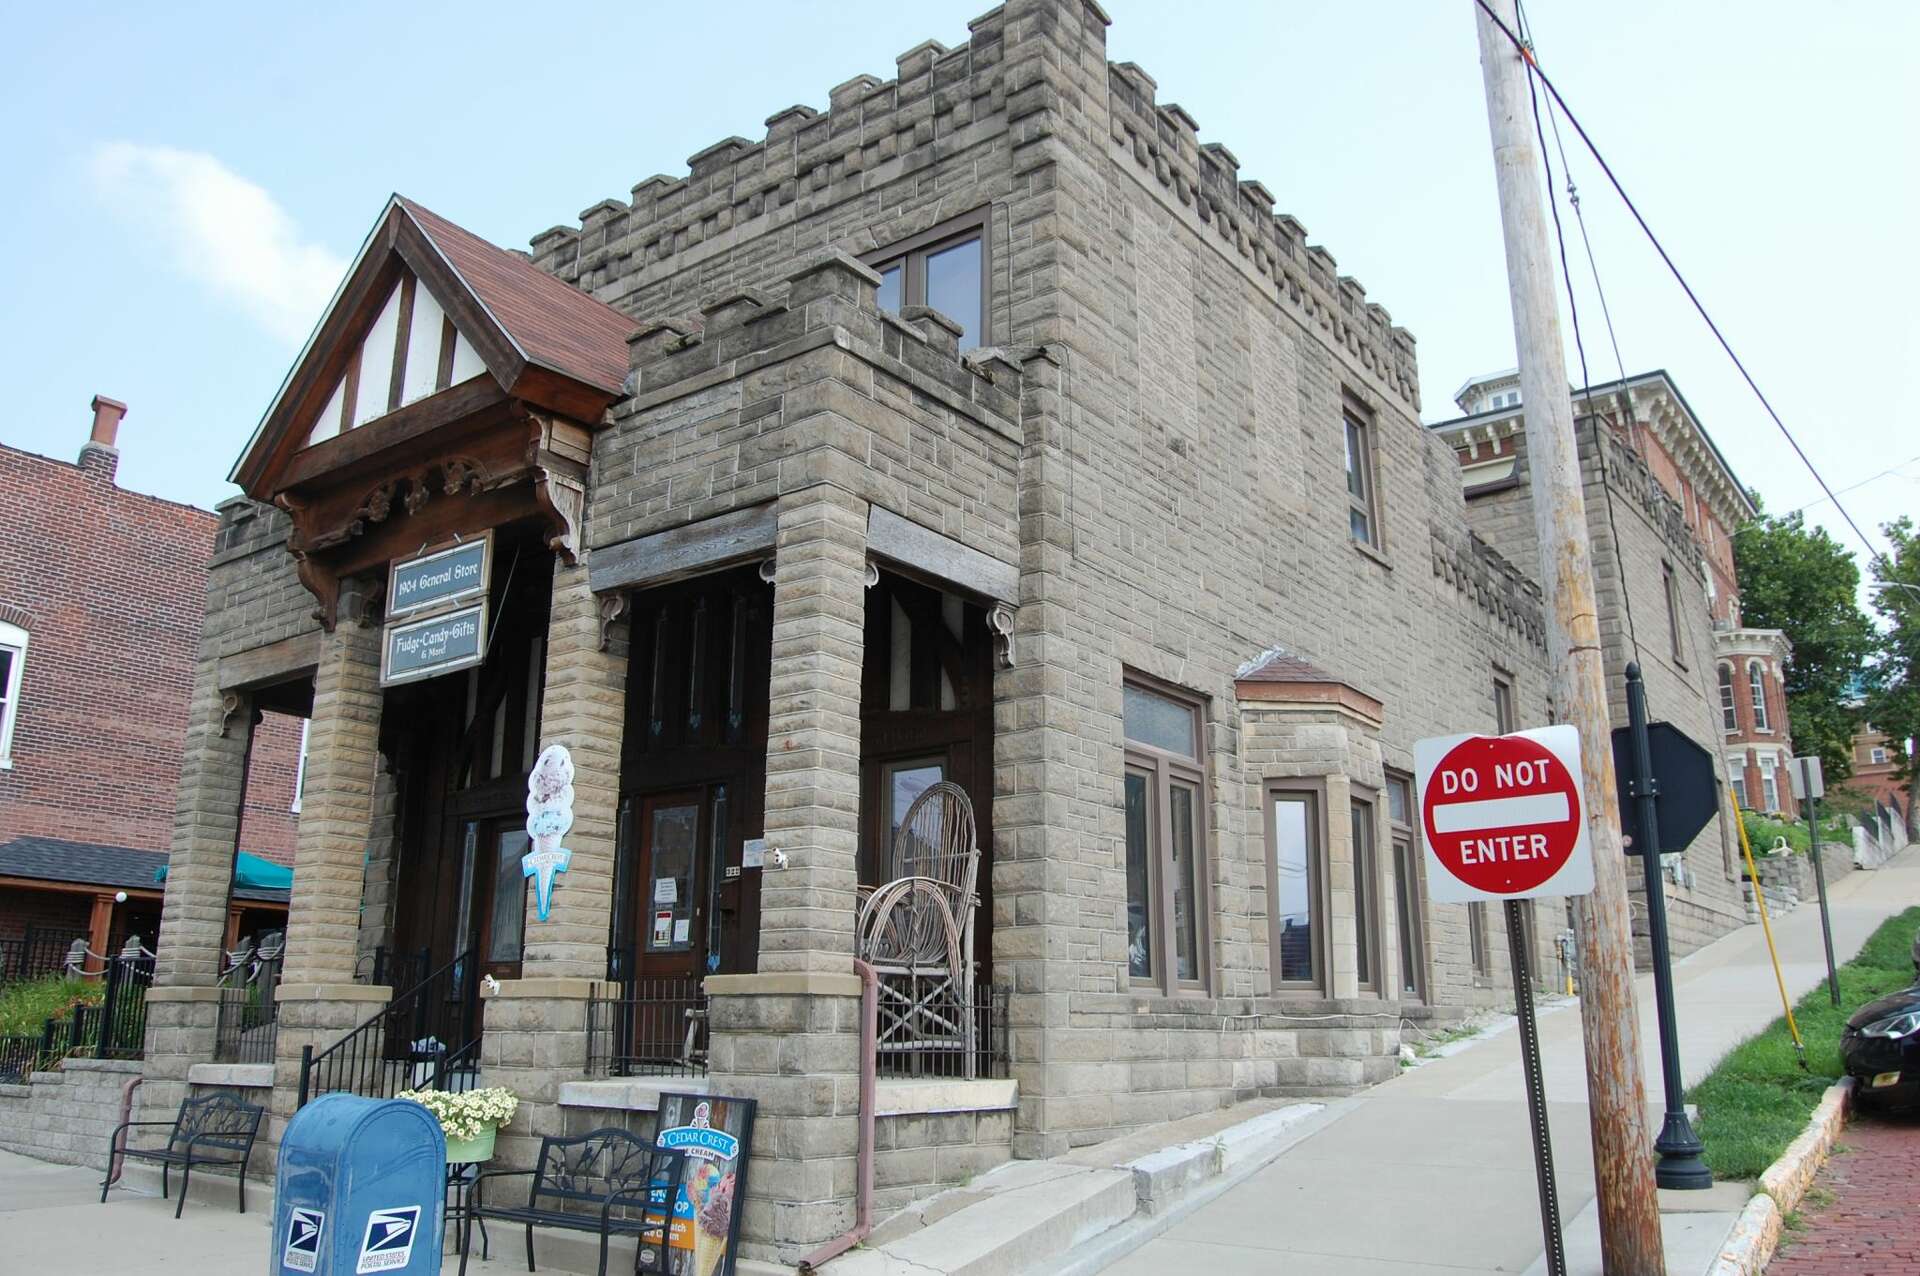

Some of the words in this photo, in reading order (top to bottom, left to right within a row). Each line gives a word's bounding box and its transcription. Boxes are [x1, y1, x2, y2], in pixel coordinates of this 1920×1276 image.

[399, 579, 417, 596] 1904
[420, 567, 452, 589] General
[454, 563, 478, 580] Store
[1441, 767, 1479, 794] DO
[1494, 759, 1550, 789] NOT
[1460, 833, 1549, 865] ENTER
[668, 1131, 699, 1146] CEDAR
[700, 1131, 730, 1150] CREST
[691, 1148, 714, 1158] CREAM
